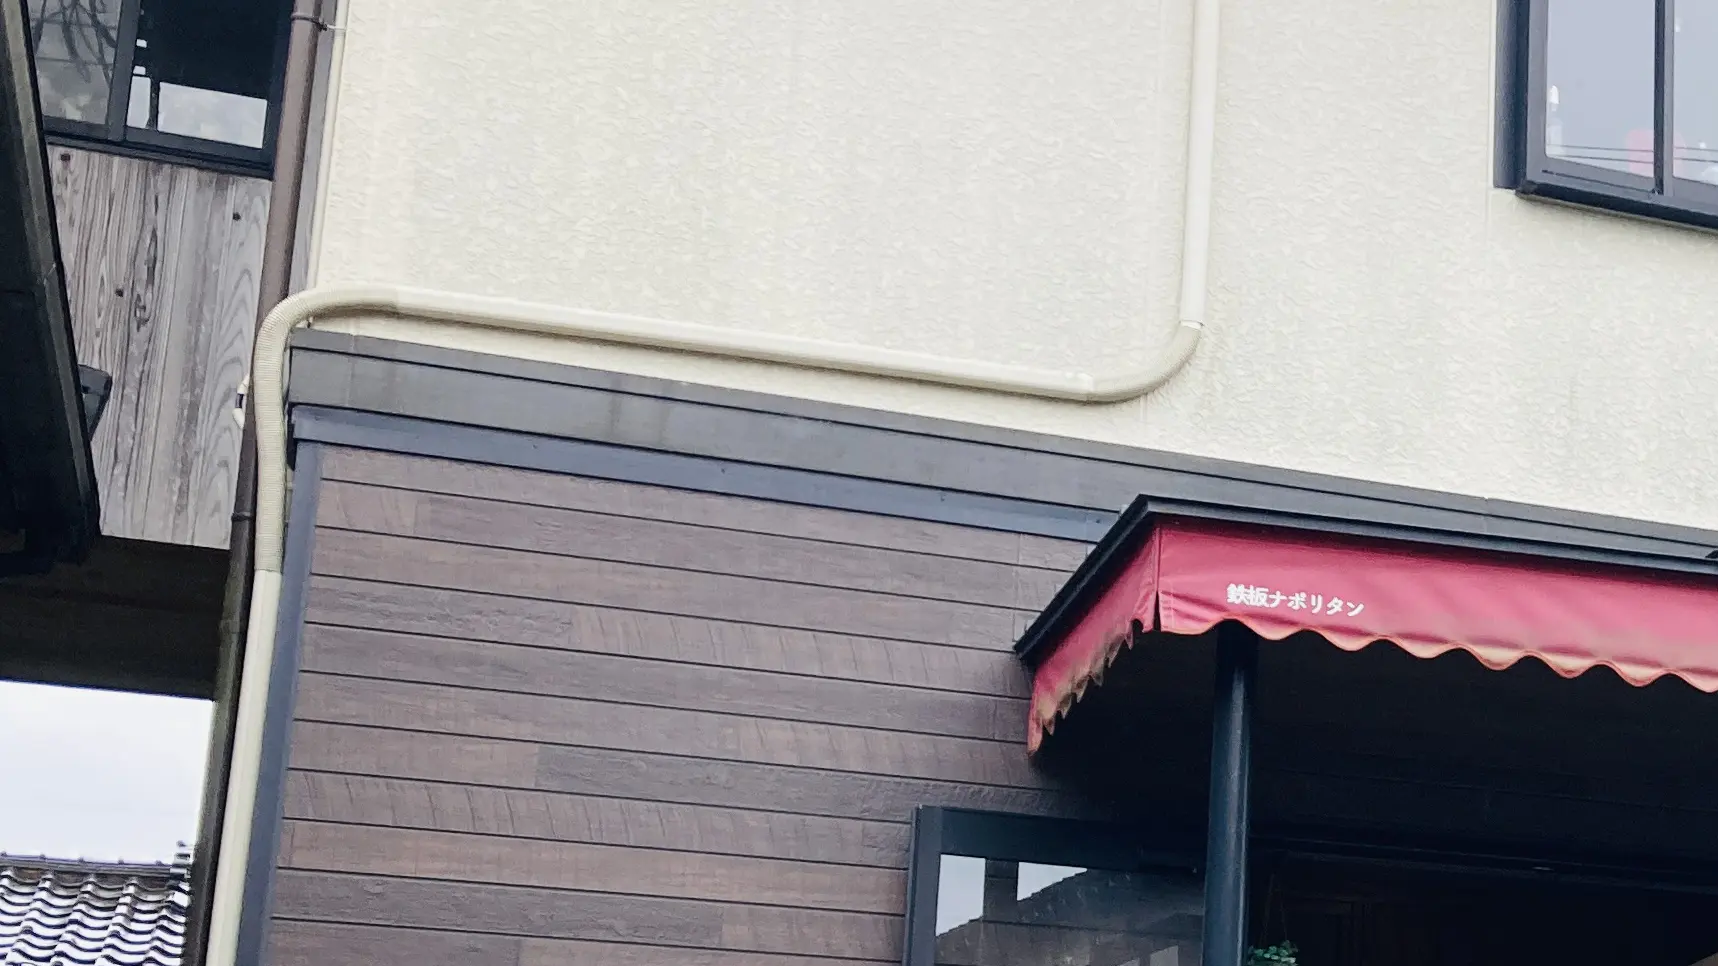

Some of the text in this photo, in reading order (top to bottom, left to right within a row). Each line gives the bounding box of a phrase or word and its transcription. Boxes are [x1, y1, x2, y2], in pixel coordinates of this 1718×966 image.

[1227, 583, 1364, 617] 鉄板ナポリタン
